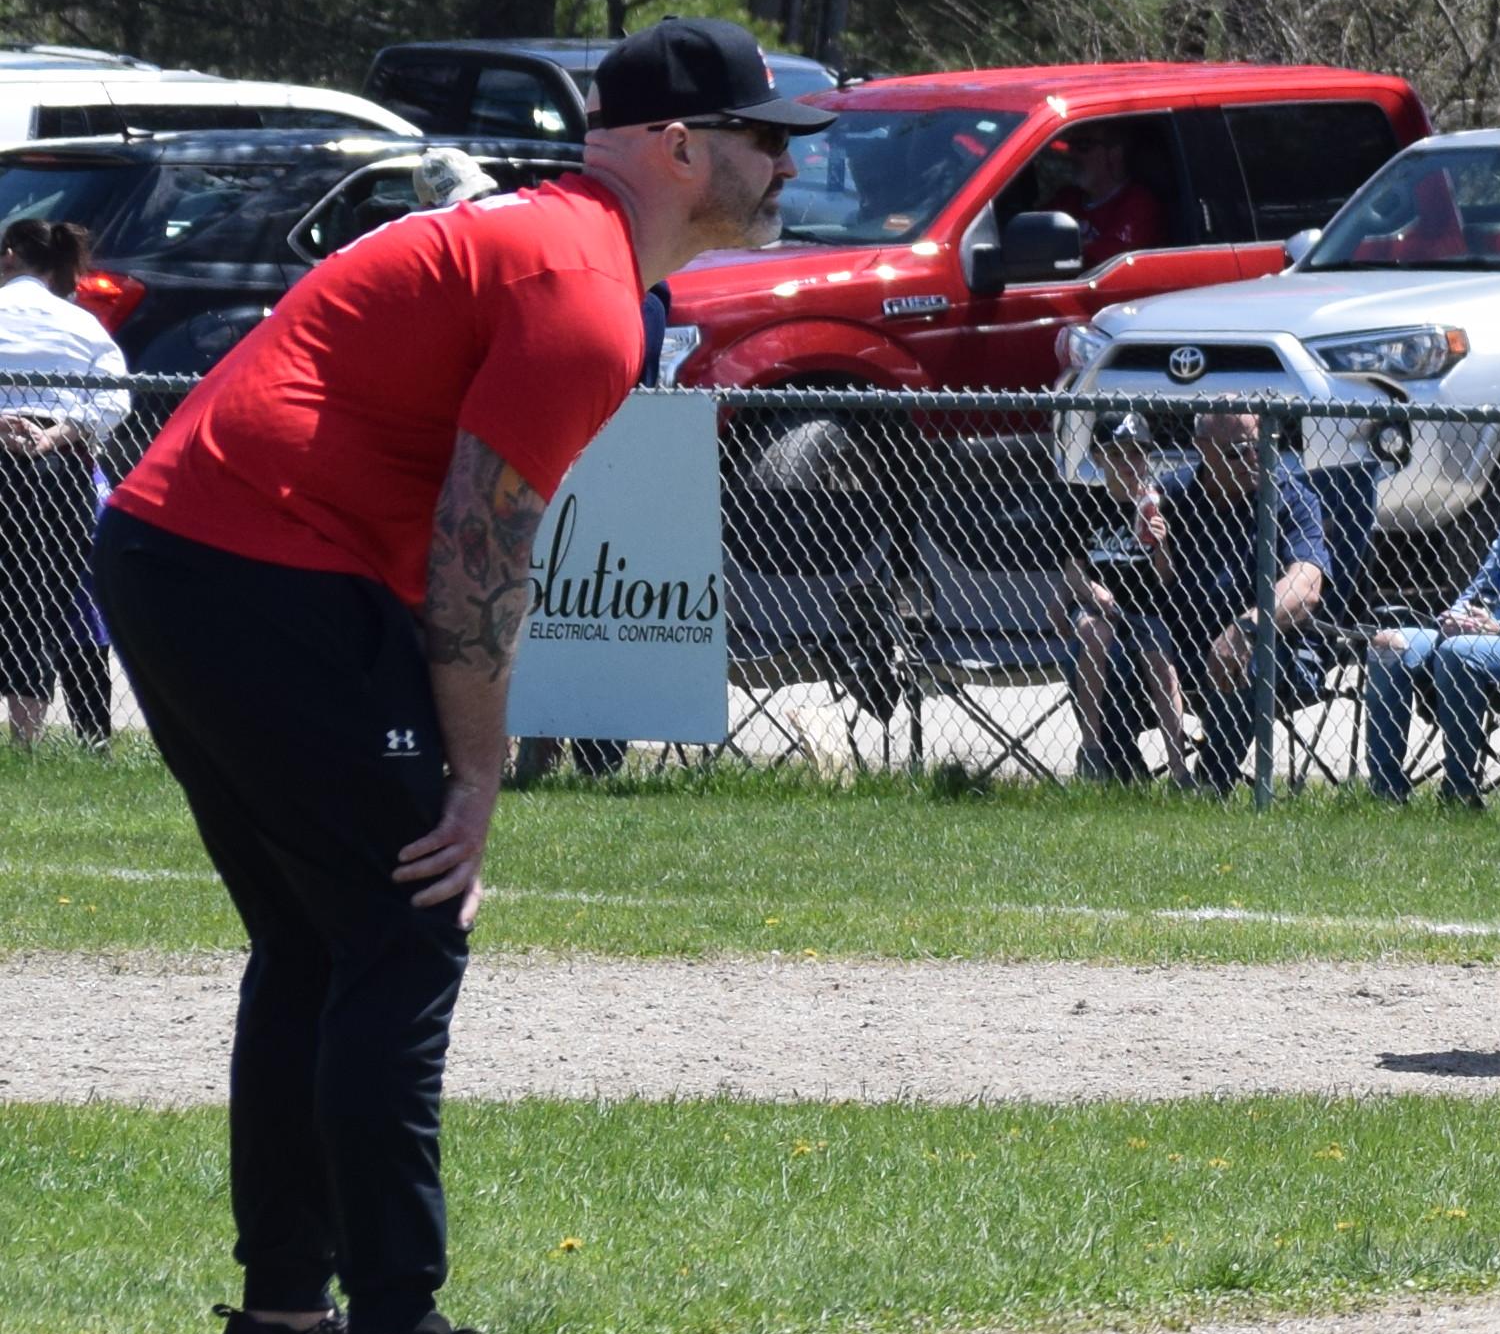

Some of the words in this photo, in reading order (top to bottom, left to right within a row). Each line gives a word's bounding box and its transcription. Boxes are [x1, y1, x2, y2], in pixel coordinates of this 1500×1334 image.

[528, 493, 719, 622] olutions
[529, 621, 610, 642] ELECTRICAL
[617, 624, 713, 644] CONTRACTOR
